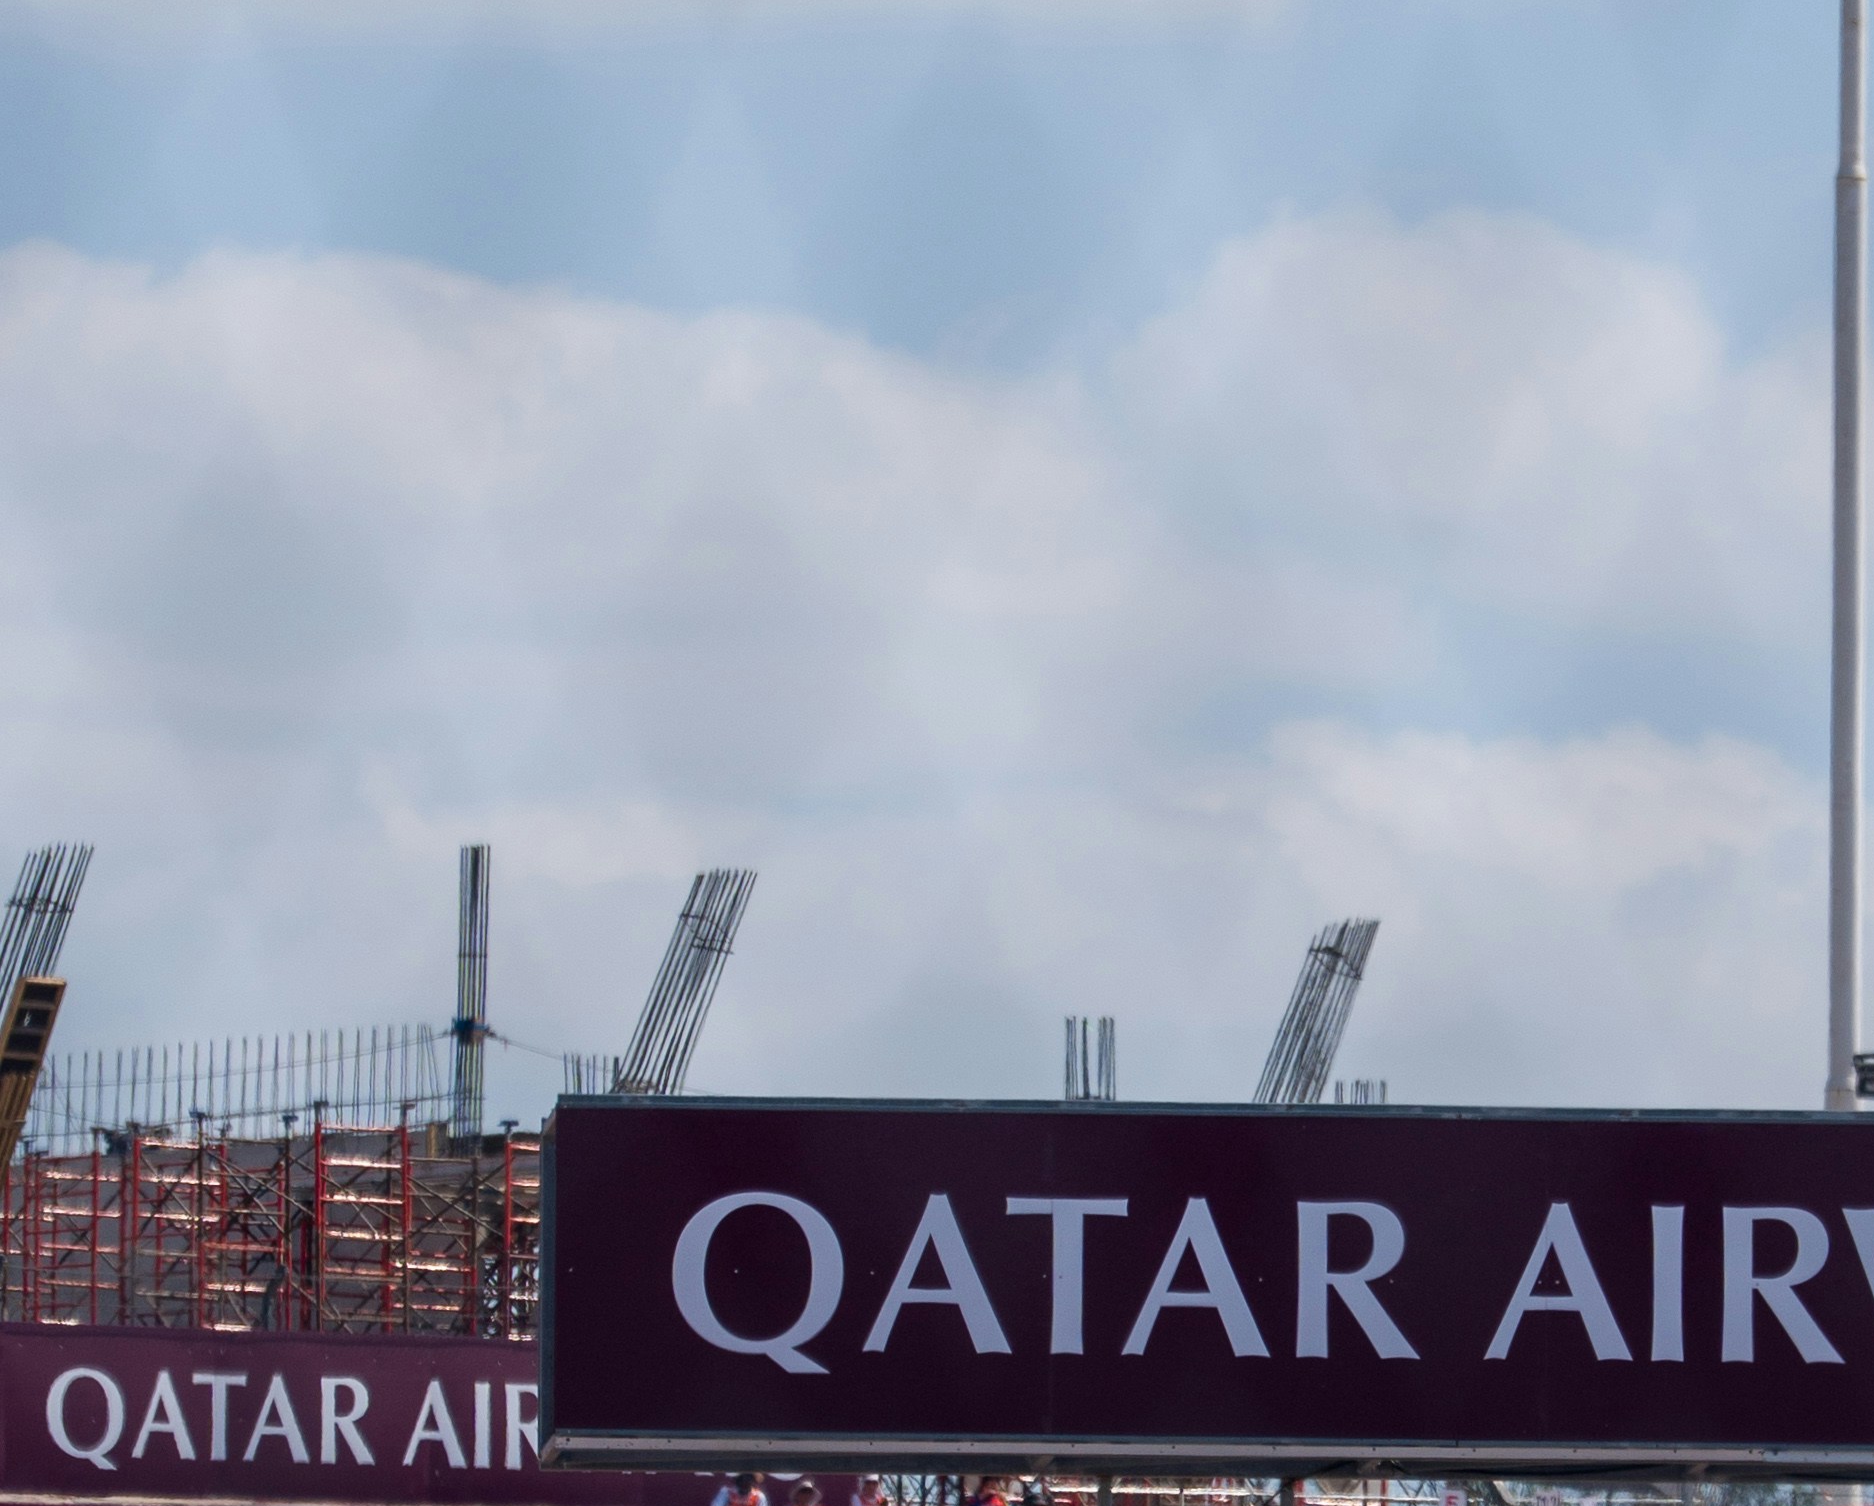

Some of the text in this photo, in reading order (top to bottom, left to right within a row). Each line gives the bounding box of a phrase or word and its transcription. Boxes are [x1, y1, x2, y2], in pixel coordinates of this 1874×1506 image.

[672, 1191, 1420, 1374] QATAR
[46, 1366, 539, 1471] QATAR AIR
